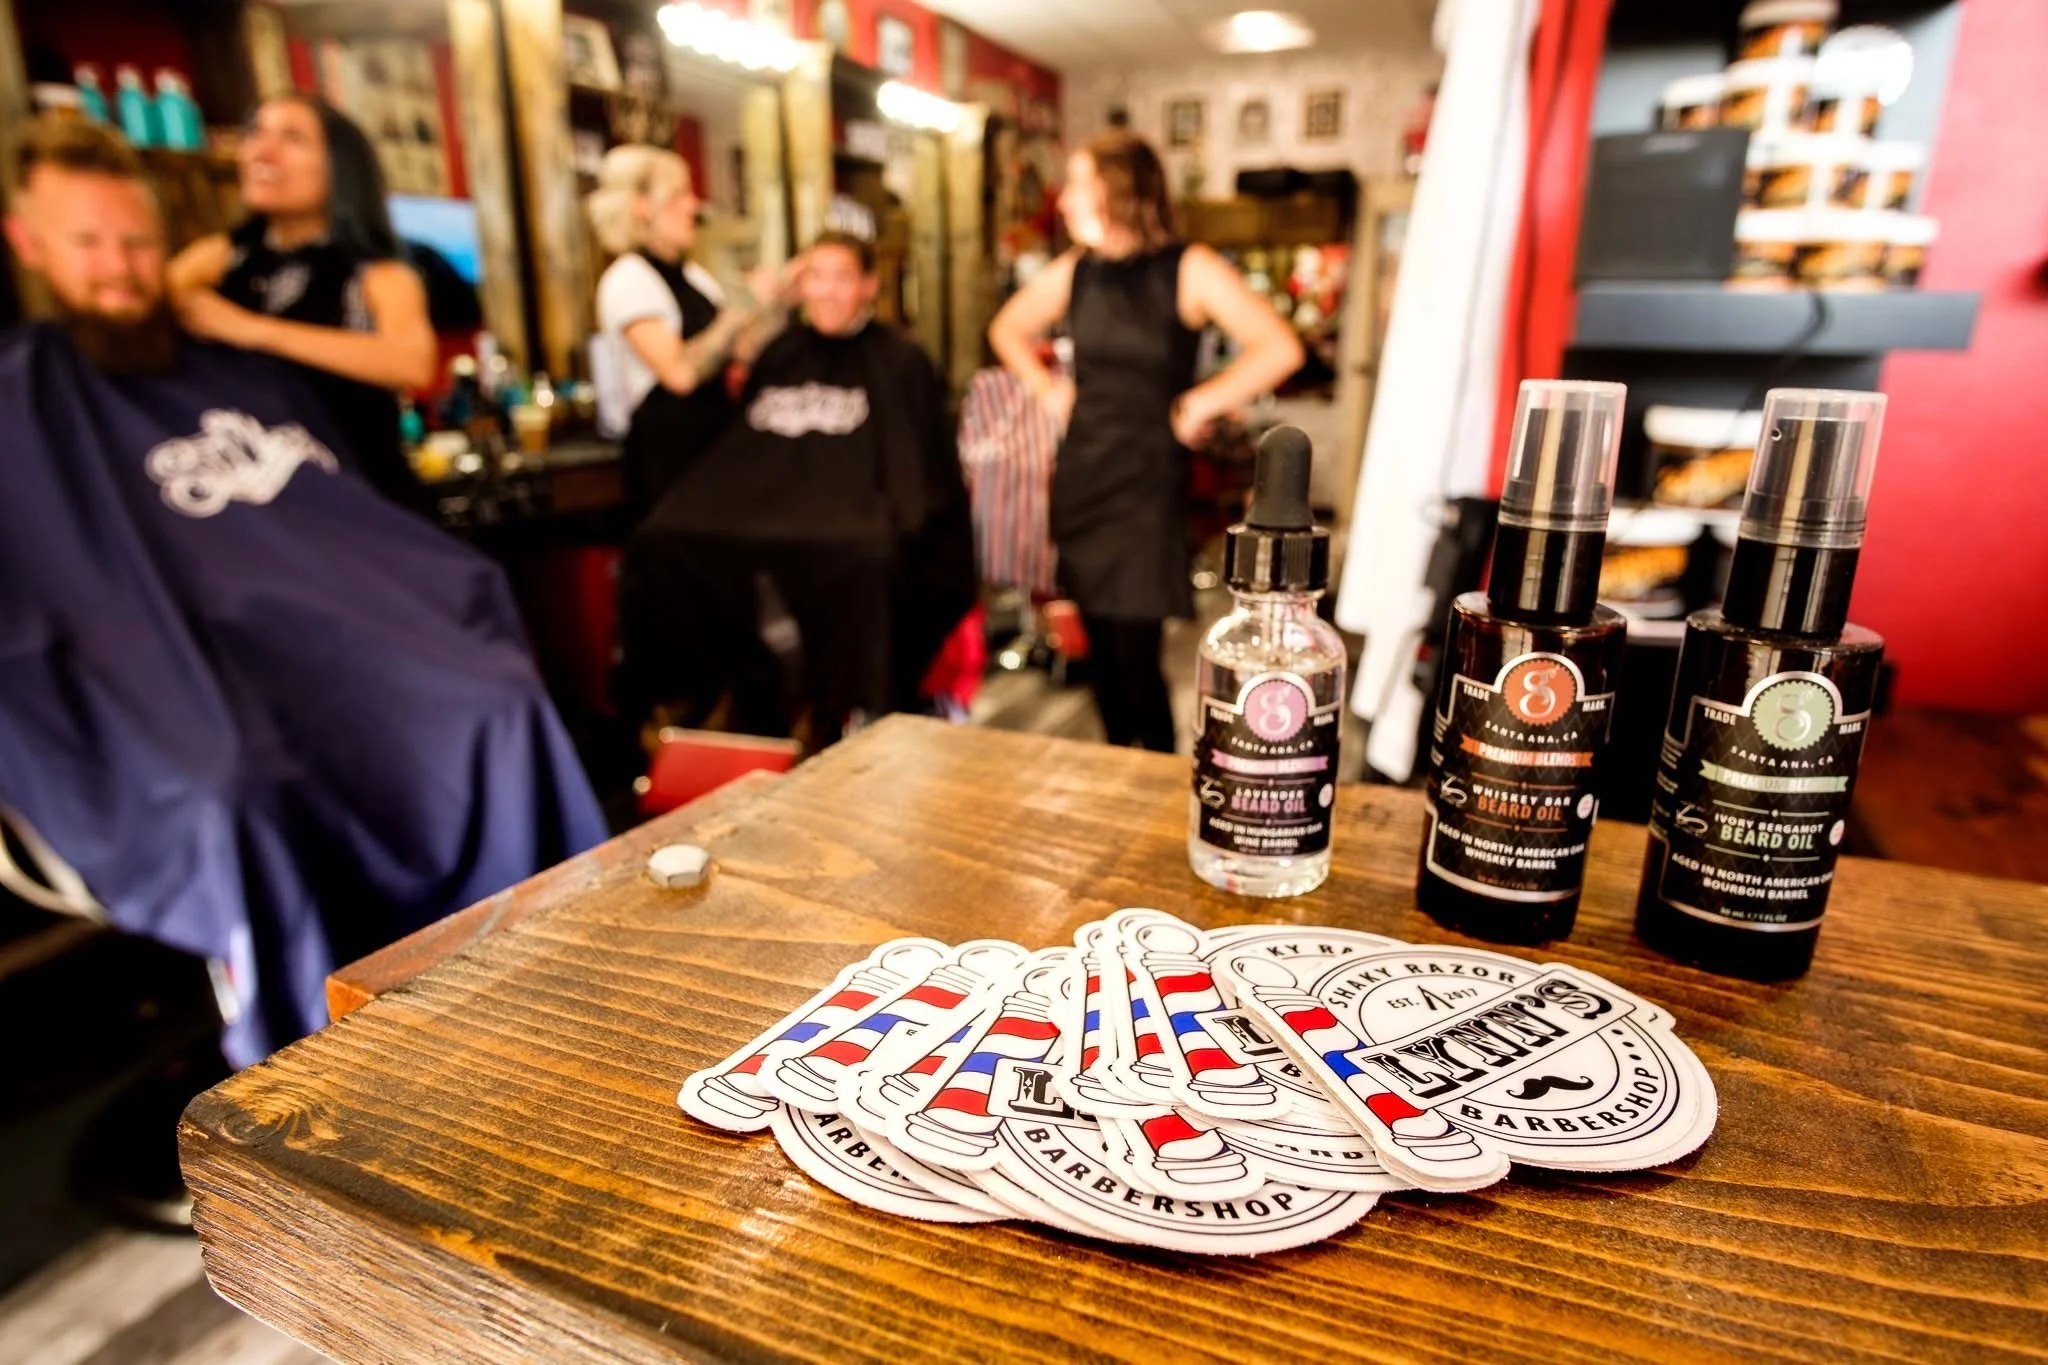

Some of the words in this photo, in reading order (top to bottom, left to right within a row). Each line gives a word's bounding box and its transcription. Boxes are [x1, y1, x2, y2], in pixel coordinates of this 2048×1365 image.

[1463, 684, 1490, 702] TRADE
[1704, 707, 1737, 726] TRADE
[1485, 719, 1524, 743] SANTA
[1562, 729, 1578, 742] CA
[1479, 741, 1534, 767] PREMIUM
[1731, 745, 1776, 768] SANTA
[1818, 754, 1834, 766] CA
[1230, 794, 1281, 814] BEARD
[1283, 799, 1307, 814] OIL
[1472, 783, 1539, 807] WHISKEY
[1544, 795, 1572, 808] BAR
[1477, 795, 1533, 820] BEARD
[1536, 805, 1562, 822] OIL
[1714, 812, 1754, 831] IVORY
[1757, 820, 1825, 834] BERGAMOT
[1438, 821, 1460, 840] AGED
[1461, 832, 1474, 845] IN
[1474, 837, 1514, 856] NORTH
[1515, 845, 1570, 859] AMERICAN
[1720, 823, 1783, 850] BEARD
[1787, 833, 1815, 851] OIL
[1464, 845, 1516, 868] WHISKEY
[1516, 858, 1557, 870] BARREL
[1672, 852, 1700, 871] AGED
[1701, 863, 1715, 877] IN
[1716, 868, 1762, 887] NORTH
[1764, 876, 1820, 888] AMERICAN
[1703, 876, 1766, 899] BOURBON
[1767, 889, 1809, 900] BARREL
[1328, 966, 1393, 1009] SHAKY
[1403, 962, 1518, 984] RAZOR
[1387, 999, 1420, 1010] EST.
[1446, 987, 1480, 1001] 2017
[1362, 979, 1613, 1100] LYNN'S
[1460, 1066, 1660, 1132] BARBERSHOP
[1023, 1127, 1294, 1221] BARBERSHOP
